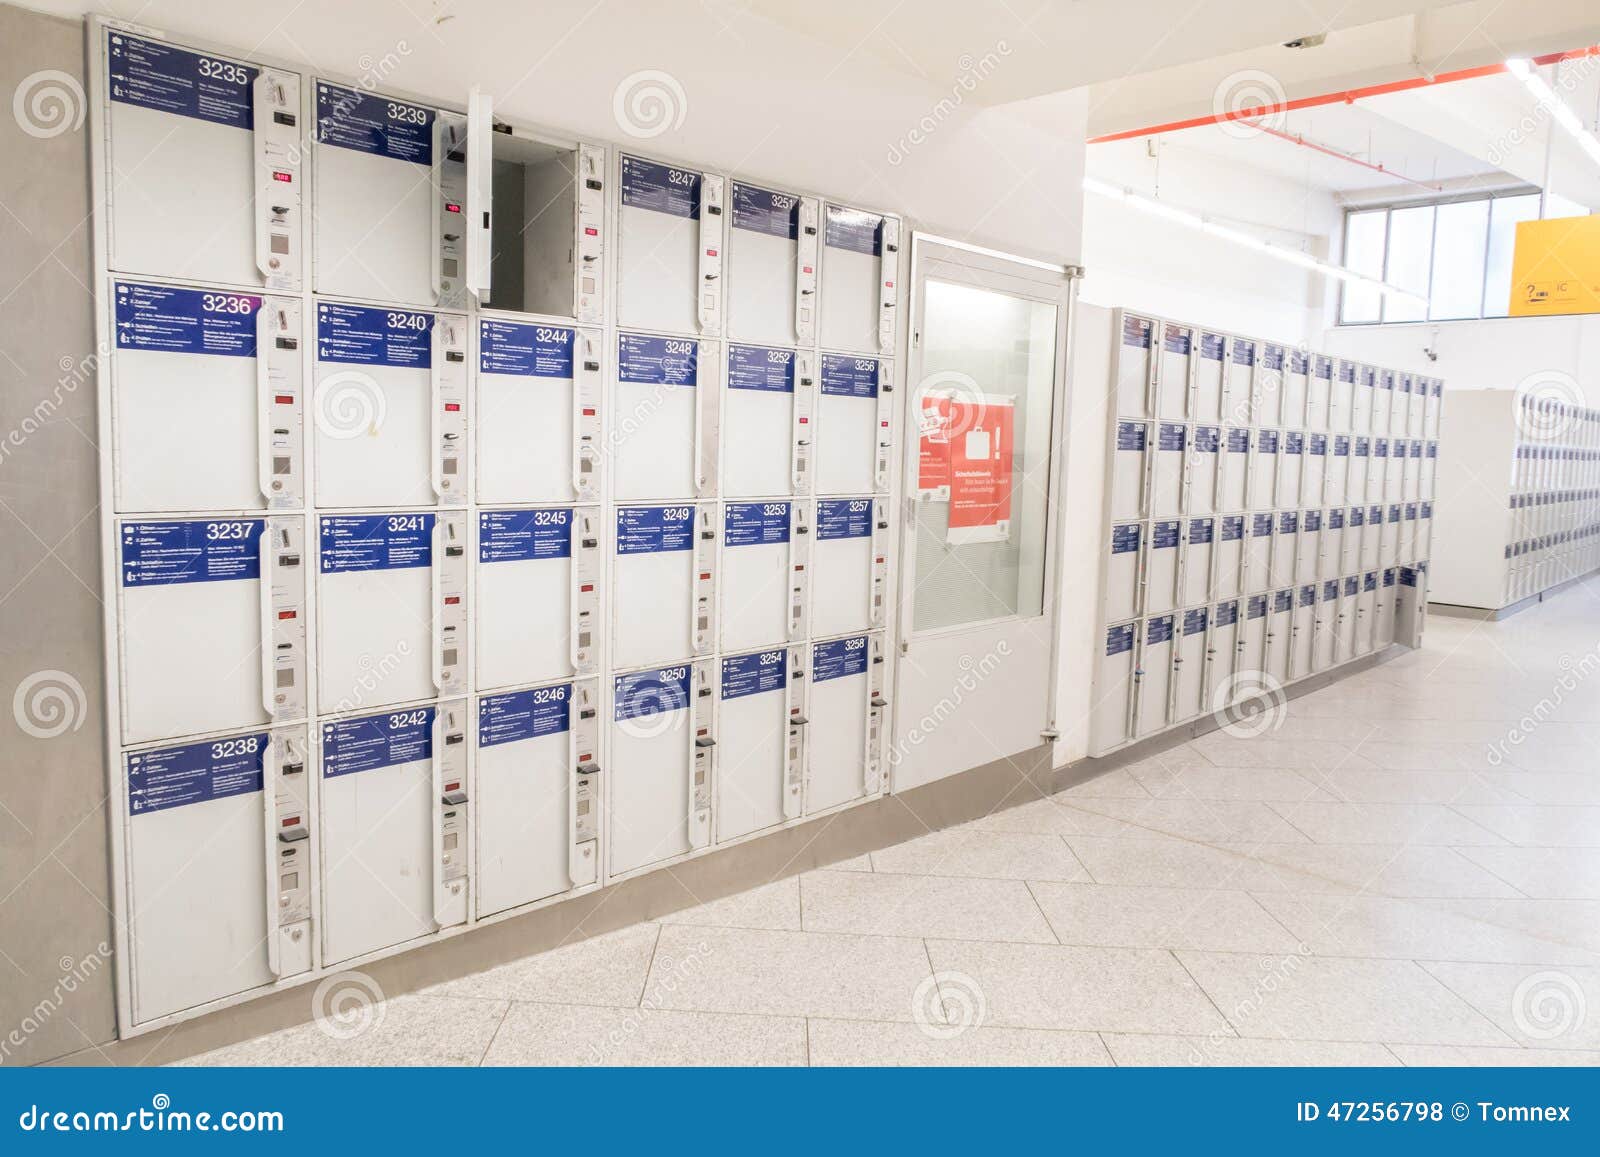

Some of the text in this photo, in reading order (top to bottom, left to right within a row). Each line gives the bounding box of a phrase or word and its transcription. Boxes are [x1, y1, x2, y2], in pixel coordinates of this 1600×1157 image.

[198, 58, 248, 85] 3235
[387, 103, 427, 125] 3239
[668, 169, 695, 187] 3247
[202, 294, 251, 315] 3236
[387, 312, 426, 331] 3240
[536, 328, 569, 344] 3244
[665, 340, 692, 355] 3248
[767, 350, 790, 364] 3252
[855, 359, 875, 372] 3256
[763, 504, 787, 516] 3253
[849, 500, 869, 512] 3257
[534, 511, 567, 526] 3245
[663, 508, 689, 521] 3249
[207, 522, 254, 540] 3237
[388, 516, 425, 532] 3241
[845, 638, 864, 651] 3258
[759, 652, 782, 666] 3254
[659, 667, 686, 682] 3250
[533, 687, 565, 704] 3246
[389, 710, 427, 729] 3242
[212, 737, 258, 759] 3238
